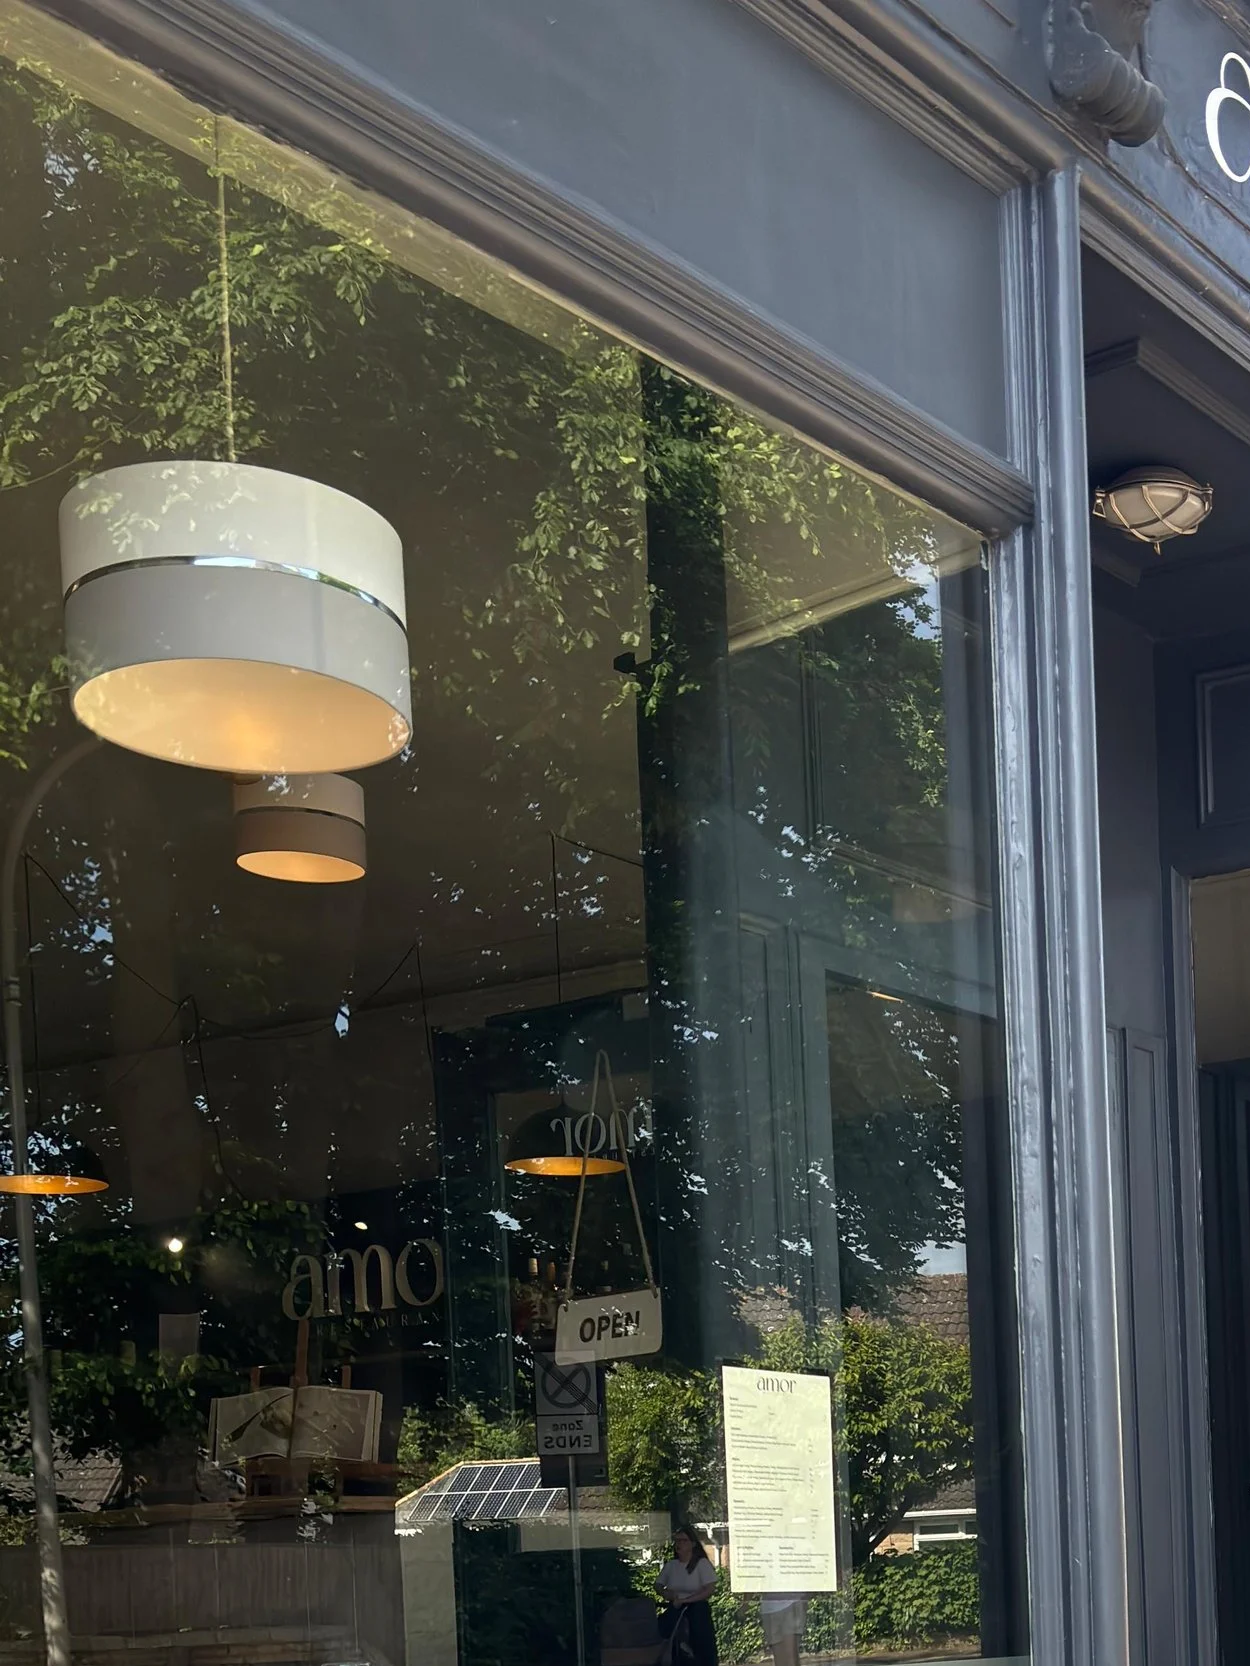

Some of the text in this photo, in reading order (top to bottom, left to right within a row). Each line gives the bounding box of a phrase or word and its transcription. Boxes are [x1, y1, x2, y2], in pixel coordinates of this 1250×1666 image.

[282, 1238, 445, 1321] amo
[579, 1310, 641, 1343] OPEN
[757, 1376, 798, 1394] amor
